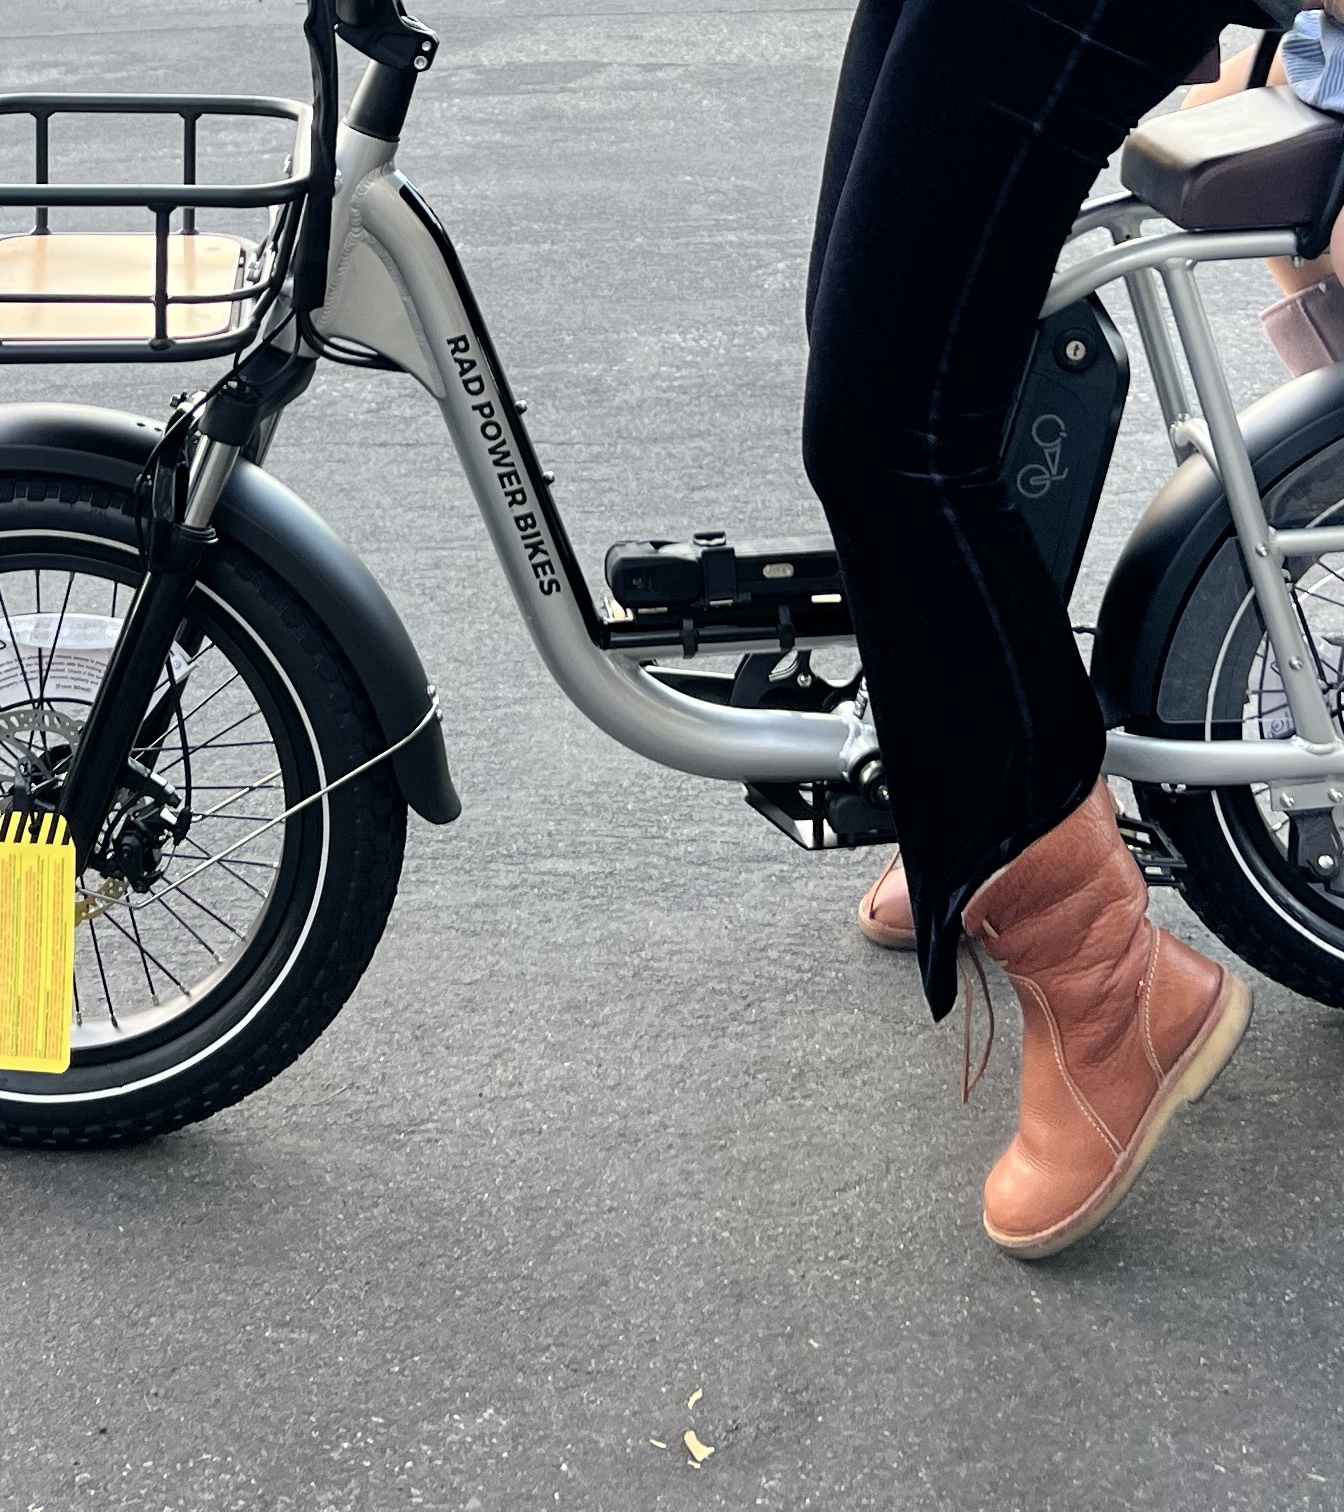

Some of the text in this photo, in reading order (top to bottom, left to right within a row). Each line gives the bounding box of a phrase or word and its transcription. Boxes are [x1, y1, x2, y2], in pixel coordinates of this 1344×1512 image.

[446, 334, 561, 597] RAD POWER BIKES
